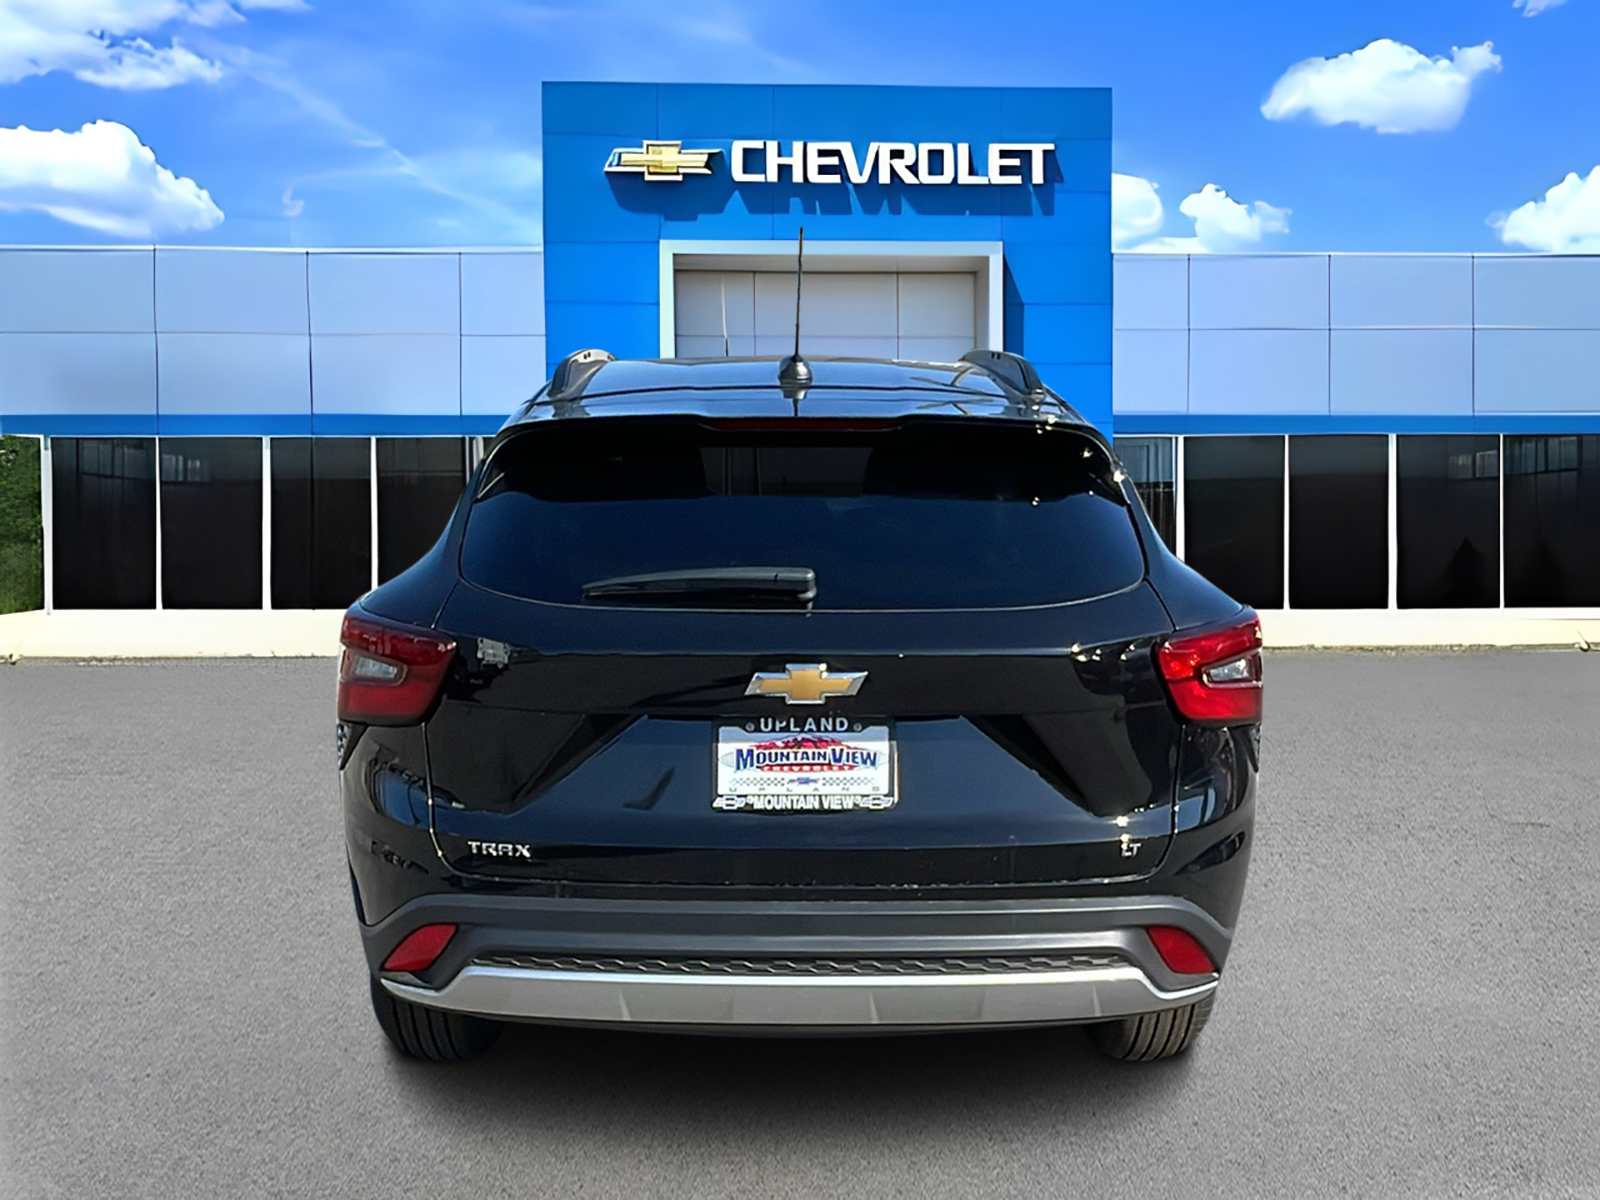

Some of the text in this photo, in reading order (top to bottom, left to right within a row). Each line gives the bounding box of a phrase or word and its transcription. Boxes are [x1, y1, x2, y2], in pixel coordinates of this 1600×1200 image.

[730, 139, 1056, 185] CHEVROLET
[760, 717, 849, 732] UPLAND
[735, 747, 878, 771] MOUNTAIN VIEW
[753, 795, 854, 810] MOUNTAIN VIEW
[467, 841, 531, 858] TRAX
[1121, 842, 1142, 858] LT
